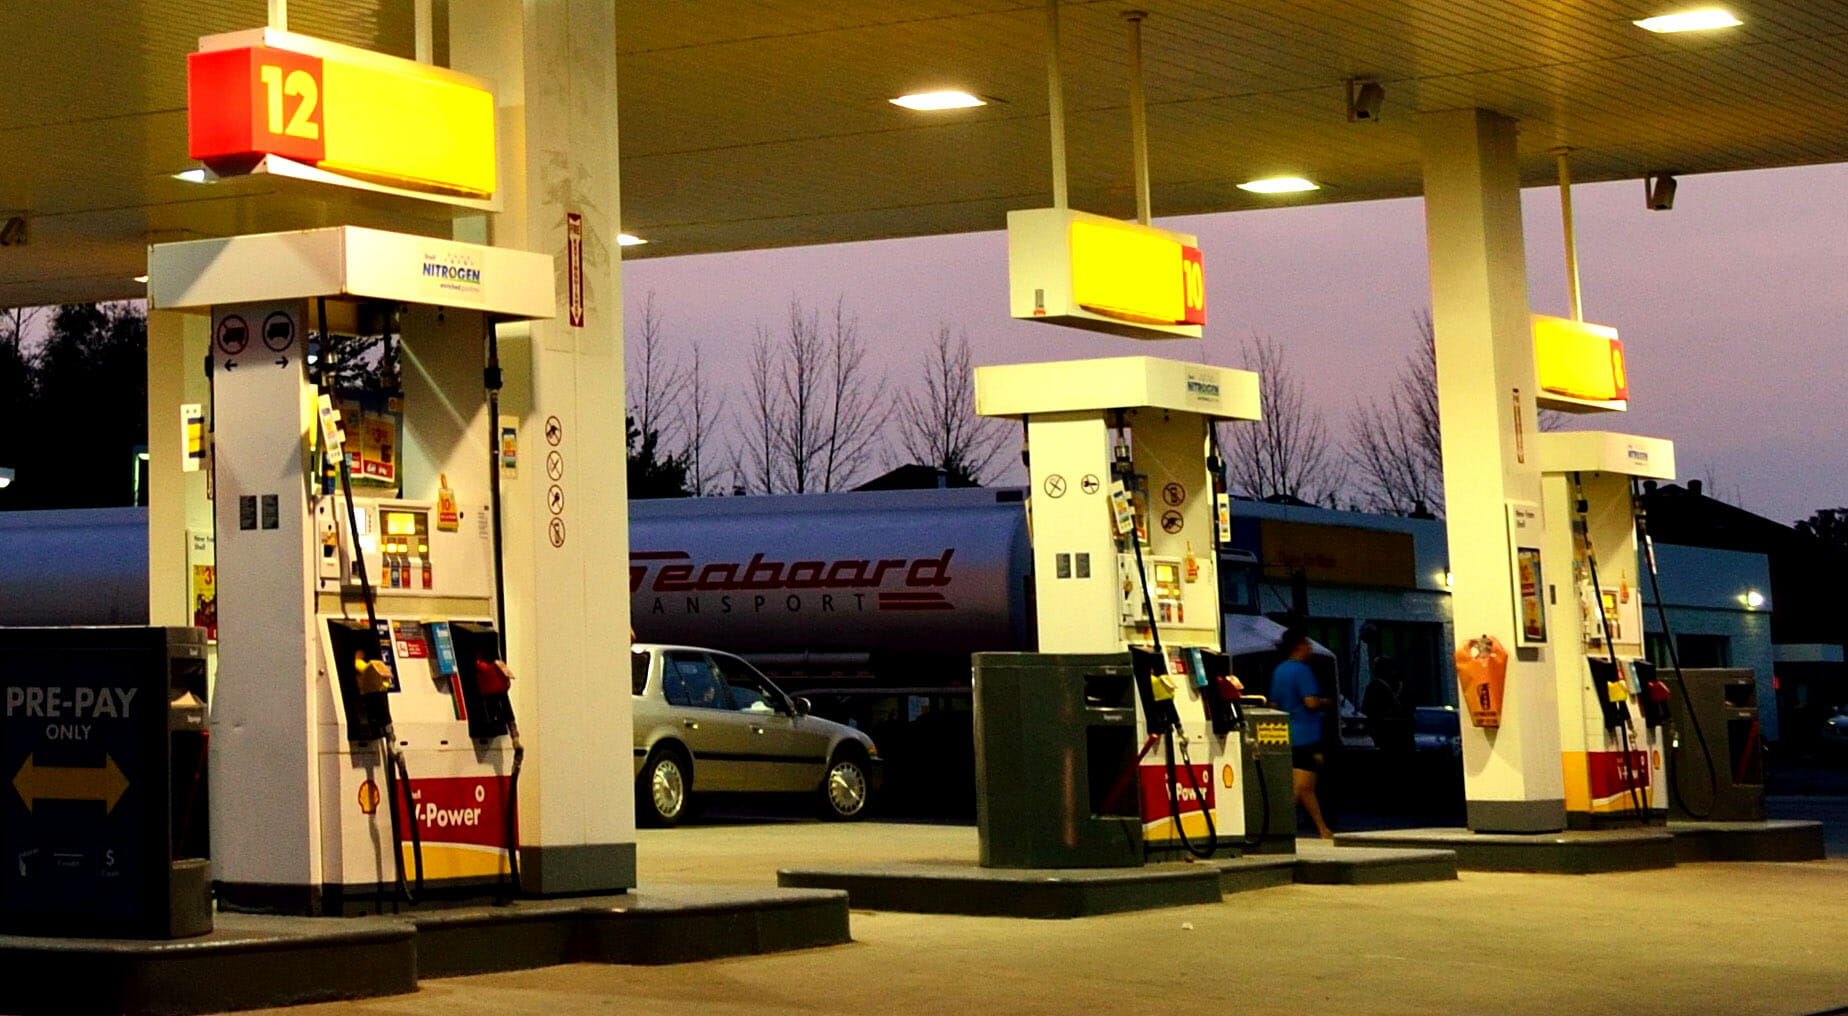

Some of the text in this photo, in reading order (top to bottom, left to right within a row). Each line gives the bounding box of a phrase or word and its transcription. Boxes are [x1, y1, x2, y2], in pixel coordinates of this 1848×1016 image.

[261, 65, 319, 139] 12
[422, 262, 481, 281] NITROGEN
[1183, 259, 1204, 311] 10
[631, 594, 866, 614] ANSPORT
[6, 686, 138, 718] PRE-PAY
[45, 724, 93, 741] ONLY
